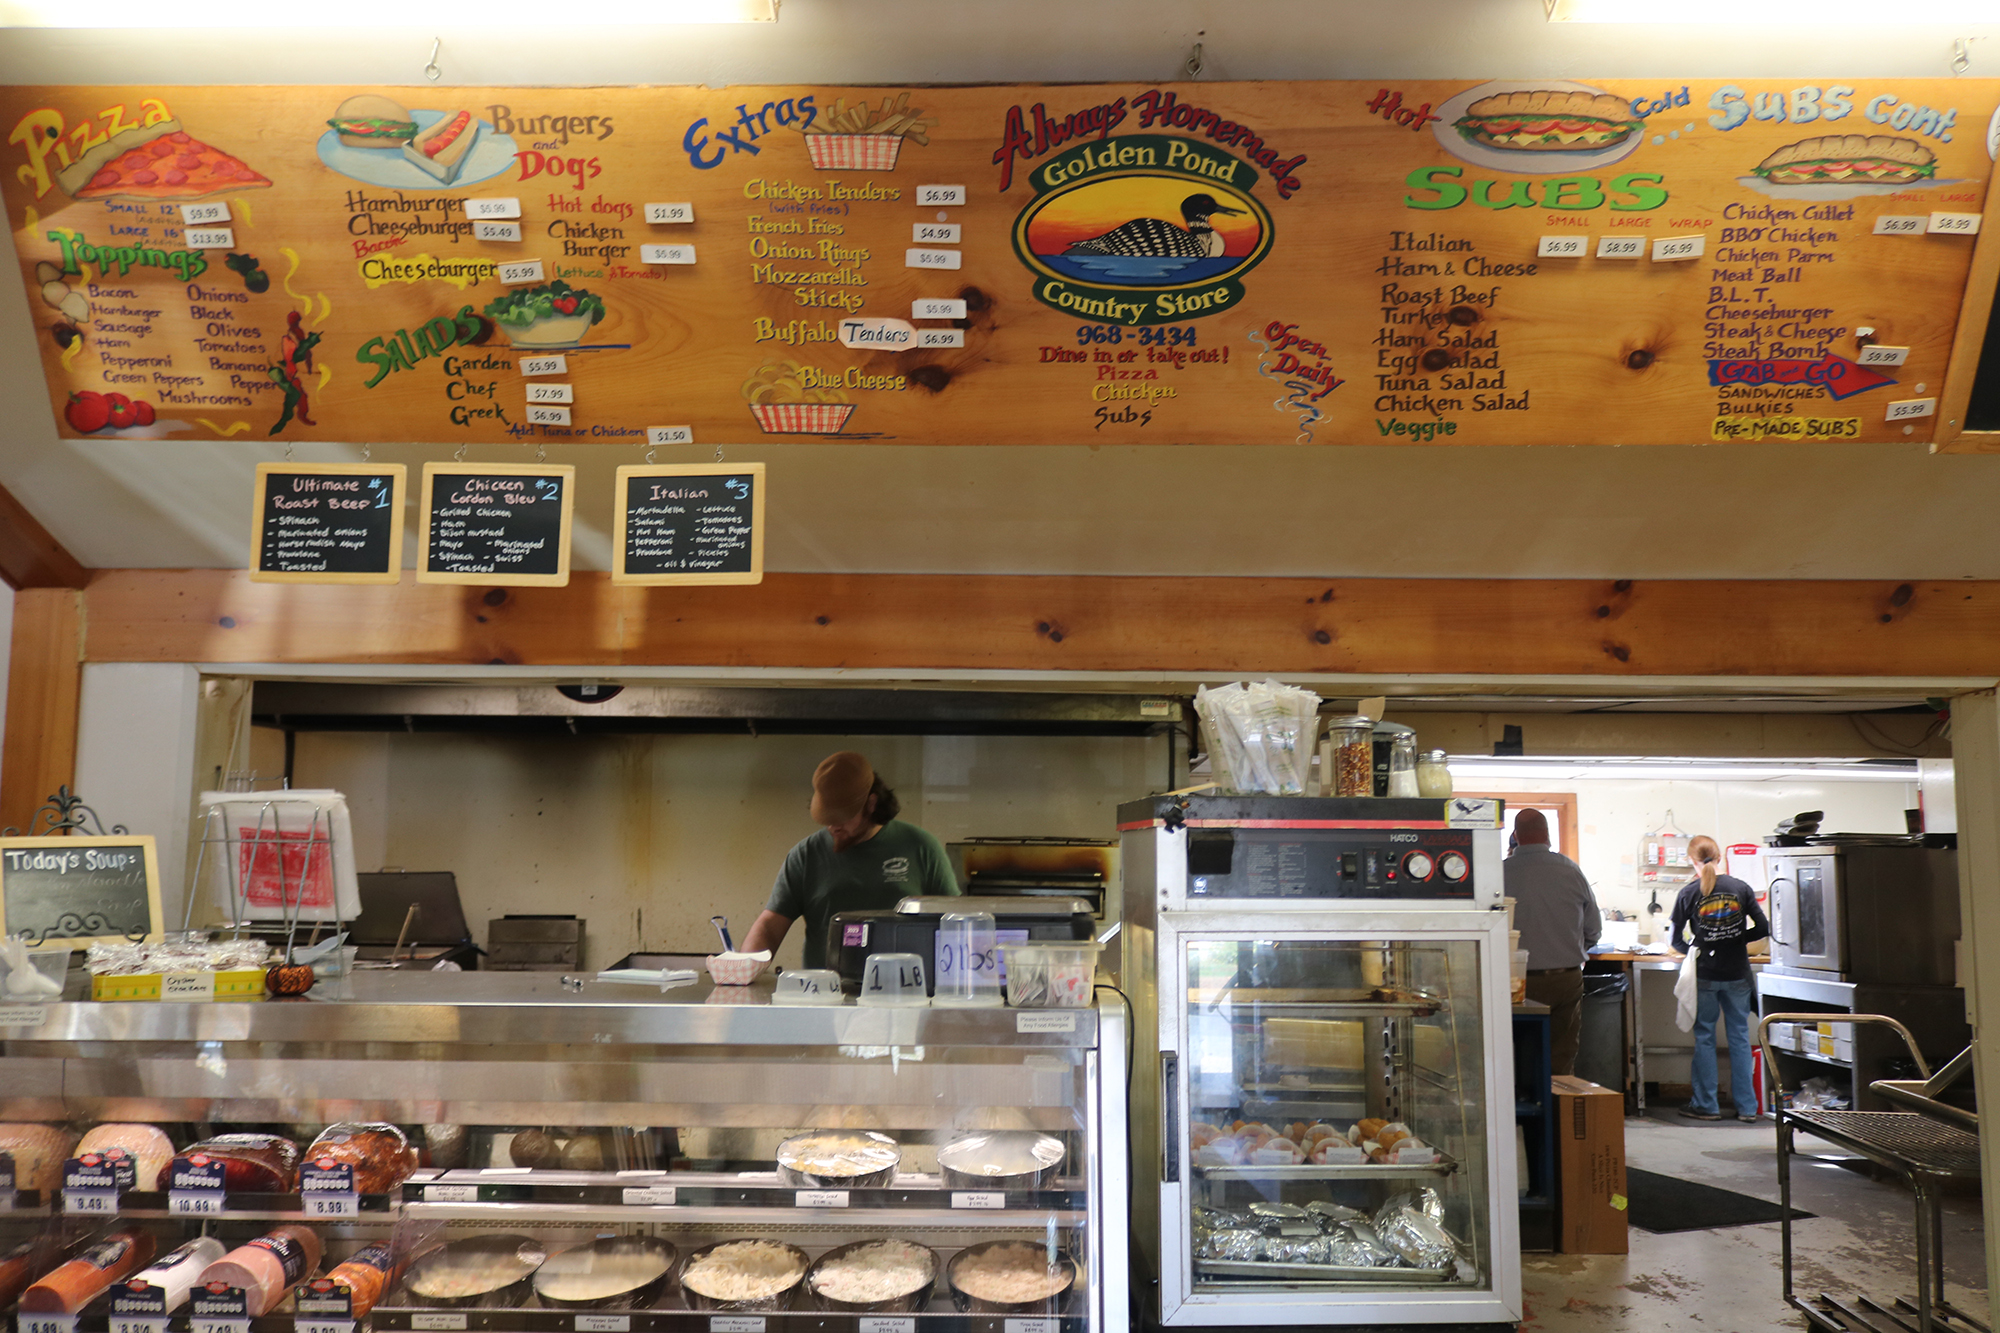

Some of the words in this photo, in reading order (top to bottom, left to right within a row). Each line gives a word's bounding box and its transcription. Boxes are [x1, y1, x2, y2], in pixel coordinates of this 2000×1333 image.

[1365, 88, 1443, 133] Hot
[1628, 86, 1691, 119] Cold
[486, 104, 614, 145] Burgers
[683, 95, 818, 170] Extras
[8, 98, 173, 200] Pizza
[533, 139, 560, 151] and
[993, 97, 1128, 193] Always
[1131, 89, 1307, 200] Homemade
[513, 150, 601, 190] Dogs
[1043, 145, 1157, 187] Golden
[1166, 140, 1239, 184] Pond
[743, 178, 823, 204] Chicken
[826, 180, 901, 201] Tenders
[925, 190, 956, 202] $6.99
[345, 191, 470, 214] Hamburger
[547, 193, 582, 213] Hot
[591, 194, 634, 222] dogs
[190, 208, 218, 220] $9.99
[654, 208, 683, 219] $1.99
[1547, 215, 1590, 227] SMALL
[1609, 216, 1653, 229] LARGE
[1669, 217, 1713, 230] WRAP
[1723, 203, 1798, 226] Chicken
[1803, 204, 1855, 221] Cutlet
[1938, 218, 1970, 229] $8.99
[348, 214, 474, 243] Cheeseburger
[483, 226, 512, 237] $5.49
[548, 219, 625, 242] Chicken
[747, 215, 804, 235] French
[807, 217, 845, 235] Fries
[920, 227, 951, 239] $4.99
[1883, 220, 1917, 231] $6.99
[192, 233, 228, 244] $13.99
[353, 235, 408, 259] Bacon
[1388, 231, 1475, 253] Italian
[1768, 227, 1839, 247] Chicken
[47, 231, 208, 282] Toppings
[562, 240, 631, 267] Burger
[749, 236, 816, 259] Onion
[817, 238, 871, 269] Rings
[1546, 241, 1578, 255] $6.99
[1606, 241, 1637, 255] $8.99
[1663, 242, 1694, 256] $6.99
[1715, 247, 1780, 269] Chicken
[1787, 248, 1835, 263] Parm
[920, 253, 946, 264] $5.99
[1375, 257, 1441, 277] Ham
[1445, 260, 1456, 276] &
[1463, 256, 1538, 277] Cheese
[362, 259, 498, 287] Cheeseburger
[505, 267, 534, 279] $5.99
[751, 264, 869, 287] Mozzarella
[1712, 268, 1754, 282] Meat
[1761, 267, 1802, 284] Ball
[88, 284, 139, 299] Bacon
[187, 284, 249, 303] Onions
[794, 287, 864, 313] Sticks
[1381, 282, 1443, 307] Roast
[1450, 285, 1501, 309] Beef
[91, 303, 163, 319] Hamburger
[190, 305, 234, 320] Black
[926, 304, 952, 314] $5.99
[1042, 281, 1147, 325] Country
[1156, 286, 1230, 318] Store
[1705, 305, 1834, 328] Cheeseburger
[95, 319, 152, 337] Sausage
[207, 322, 261, 338] Olives
[754, 316, 838, 345] Buffalo
[844, 322, 910, 344] Tenders
[1372, 328, 1428, 347] Ham
[1437, 330, 1500, 348] Salad
[1703, 322, 1764, 345] Steak
[1765, 326, 1774, 337] &
[1777, 321, 1847, 341] Cheese
[95, 337, 131, 349] Ham
[193, 338, 266, 353] Tomatoes
[925, 334, 954, 345] $6.99
[1264, 320, 1332, 361] Open
[101, 352, 173, 369] Pepperoni
[1039, 346, 1087, 364] Dine
[1093, 348, 1113, 363] in
[1117, 349, 1137, 363] or
[1147, 346, 1187, 370] take
[1189, 346, 1229, 364] out!
[1703, 342, 1761, 362] Steak
[1768, 342, 1831, 360] Bomb
[1865, 350, 1898, 363] $9.99
[209, 356, 267, 372] Banana
[443, 355, 512, 377] Garden
[528, 360, 557, 372] $5.99
[1378, 349, 1419, 376] Egg
[1804, 362, 1846, 380] GO
[103, 370, 147, 384] Green
[153, 371, 204, 387] Peppers
[799, 366, 843, 391] Blue
[844, 366, 907, 392] Cheese
[1097, 365, 1159, 381] Pizza
[1270, 352, 1346, 402] Daily
[1375, 374, 1431, 391] Tuna
[1440, 370, 1508, 391] Salad
[158, 389, 252, 407] Mushrooms
[446, 381, 498, 401] Chef
[534, 388, 563, 399] $7.99
[1092, 382, 1178, 409] Chicken
[1718, 384, 1826, 399] SANDWICHES
[1374, 395, 1464, 417] Chicken
[1471, 390, 1530, 412] Salad
[1893, 404, 1925, 416] $5.99
[450, 403, 510, 427] Greek
[533, 410, 562, 422] $6.99
[1094, 406, 1153, 432] Subs
[506, 423, 535, 439] Add
[539, 424, 572, 436] Tuna
[575, 428, 588, 436] or
[592, 425, 646, 437] Chicken
[657, 430, 685, 442] $1.50
[1375, 417, 1458, 442] Veggie
[293, 478, 360, 492] Ultimate
[465, 479, 525, 492] Chicken
[649, 485, 709, 500] Italian
[272, 494, 320, 510] Roast
[450, 492, 494, 504] Cordon
[504, 493, 536, 504] Bleu
[1390, 834, 1418, 842] HATCO
[5, 850, 80, 875] Today's
[85, 849, 136, 871] Soup:
[869, 965, 883, 991] 1
[900, 966, 923, 988] LB
